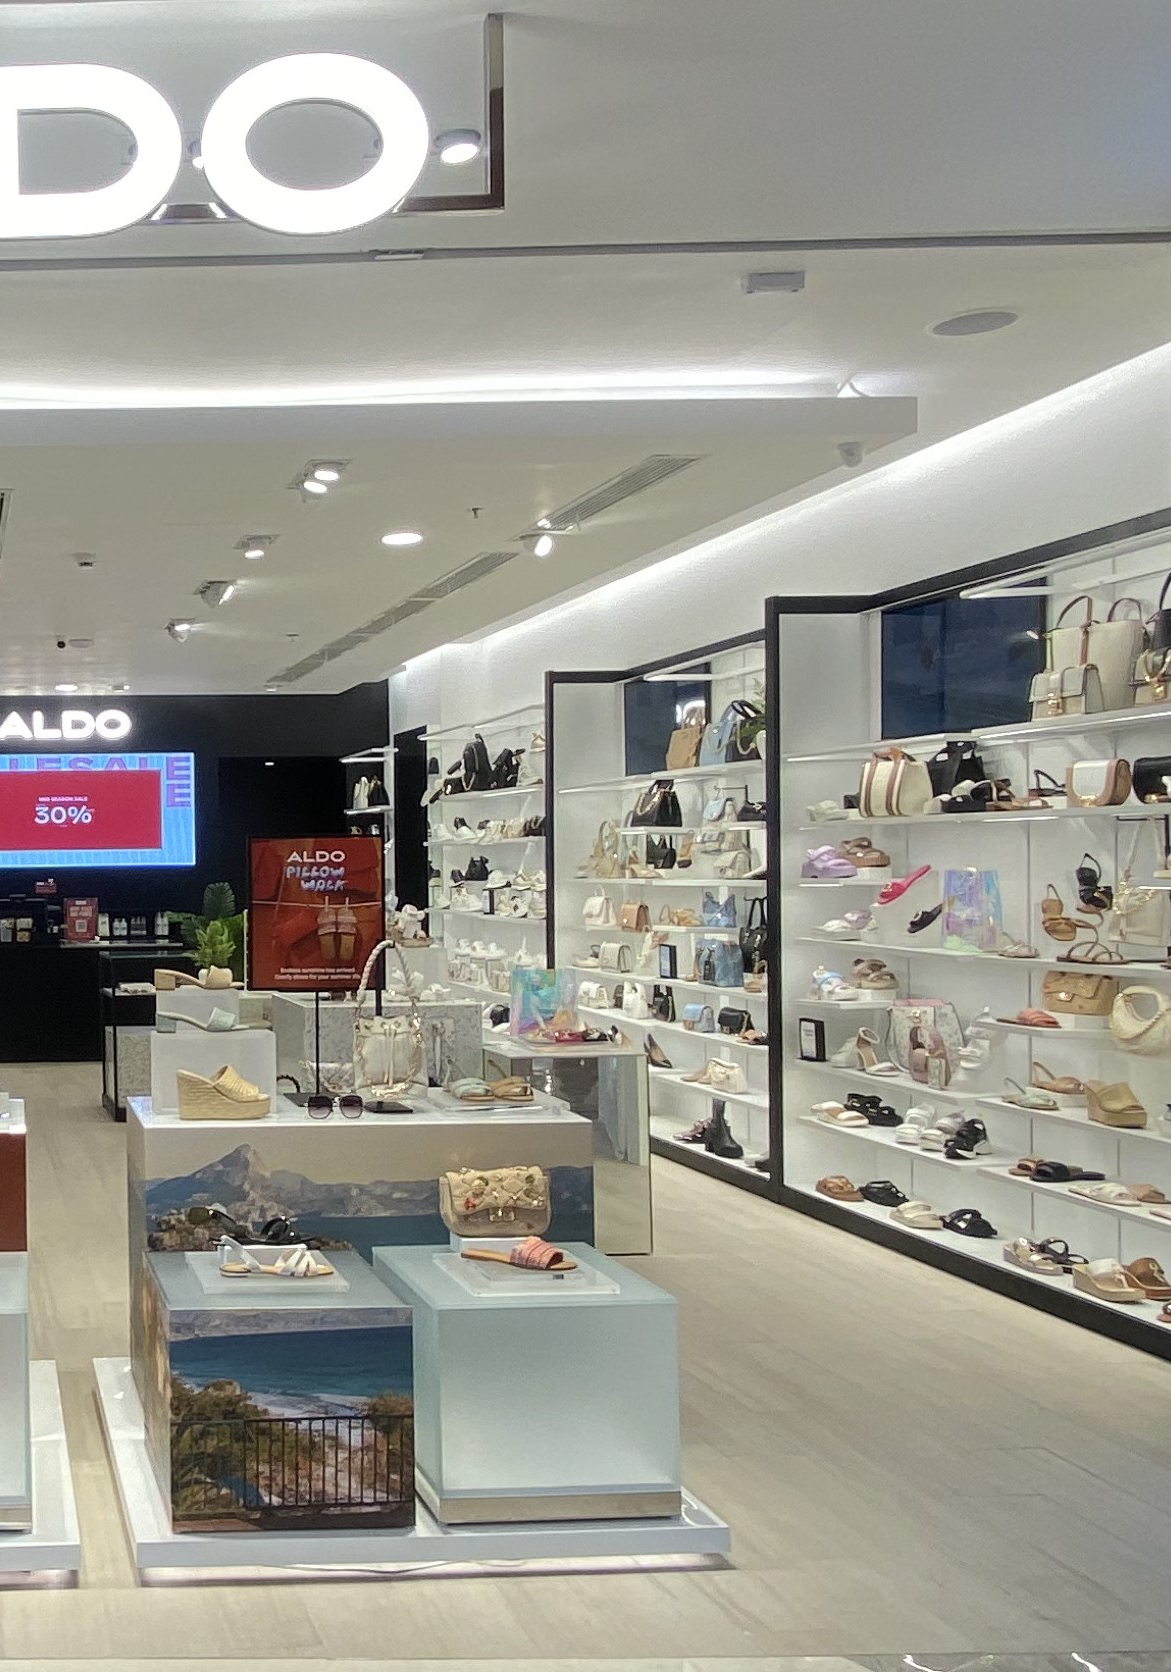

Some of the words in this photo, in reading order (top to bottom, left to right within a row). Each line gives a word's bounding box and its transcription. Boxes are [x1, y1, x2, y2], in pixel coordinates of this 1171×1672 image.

[34, 805, 92, 824] 30%
[287, 851, 345, 862] ALDO
[286, 866, 345, 878] PILLOW
[301, 879, 345, 891] WALK
